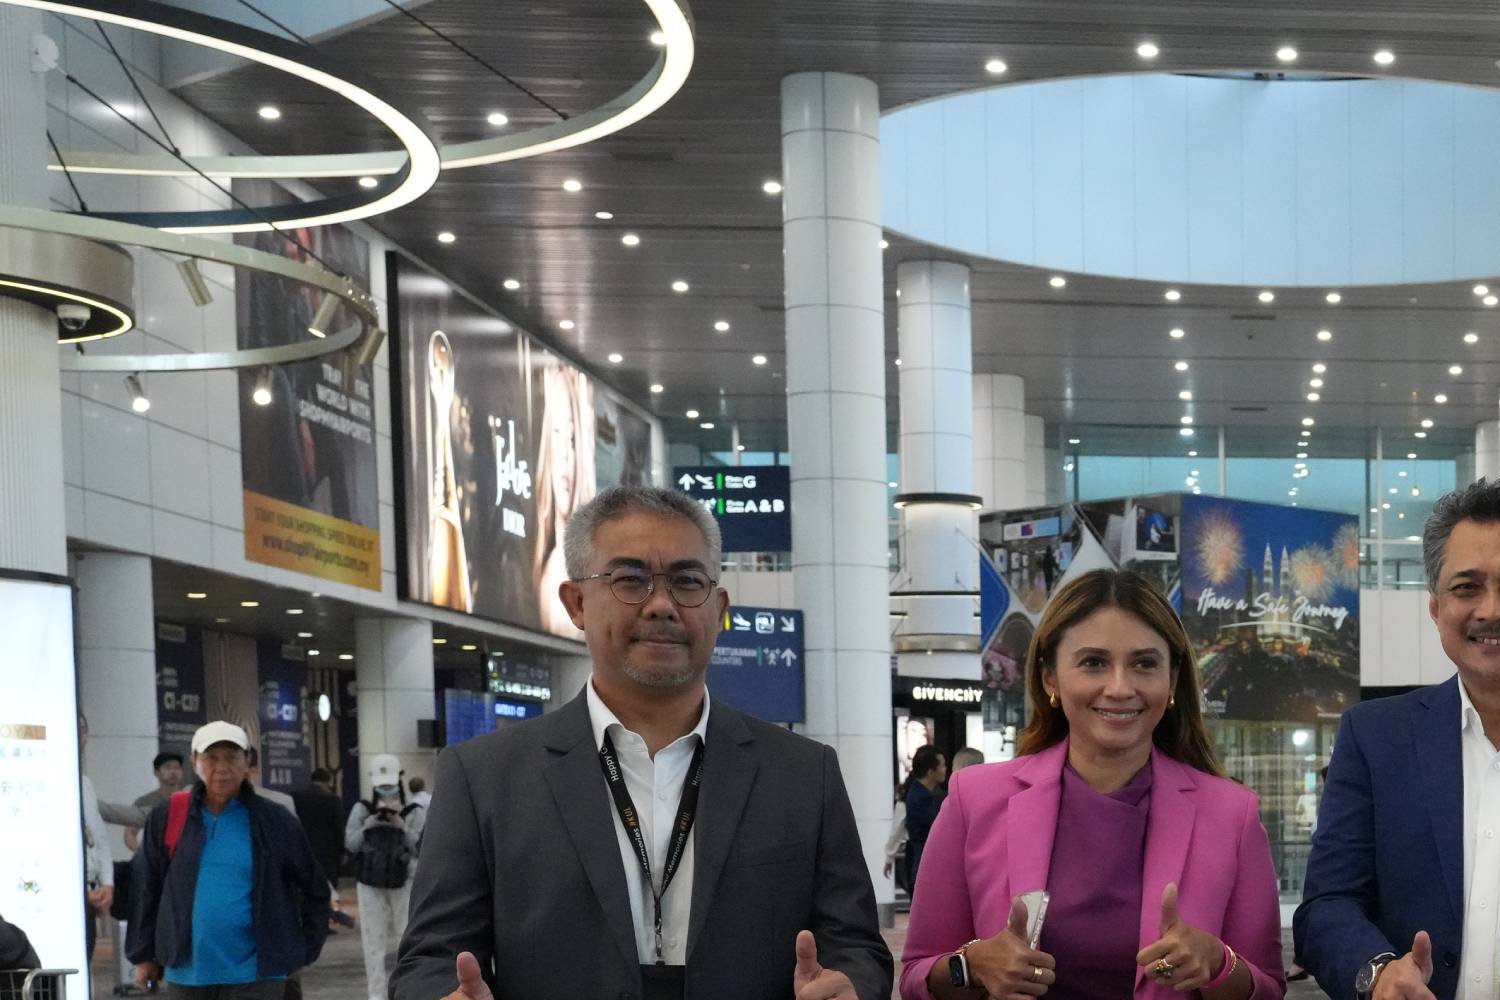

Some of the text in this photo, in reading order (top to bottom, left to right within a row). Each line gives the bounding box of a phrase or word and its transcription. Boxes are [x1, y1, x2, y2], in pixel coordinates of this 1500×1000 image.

[743, 475, 757, 488] G
[1197, 587, 1349, 630] Have a Safe Journey
[912, 686, 984, 702] GIVENCHY
[604, 754, 620, 782] Happy
